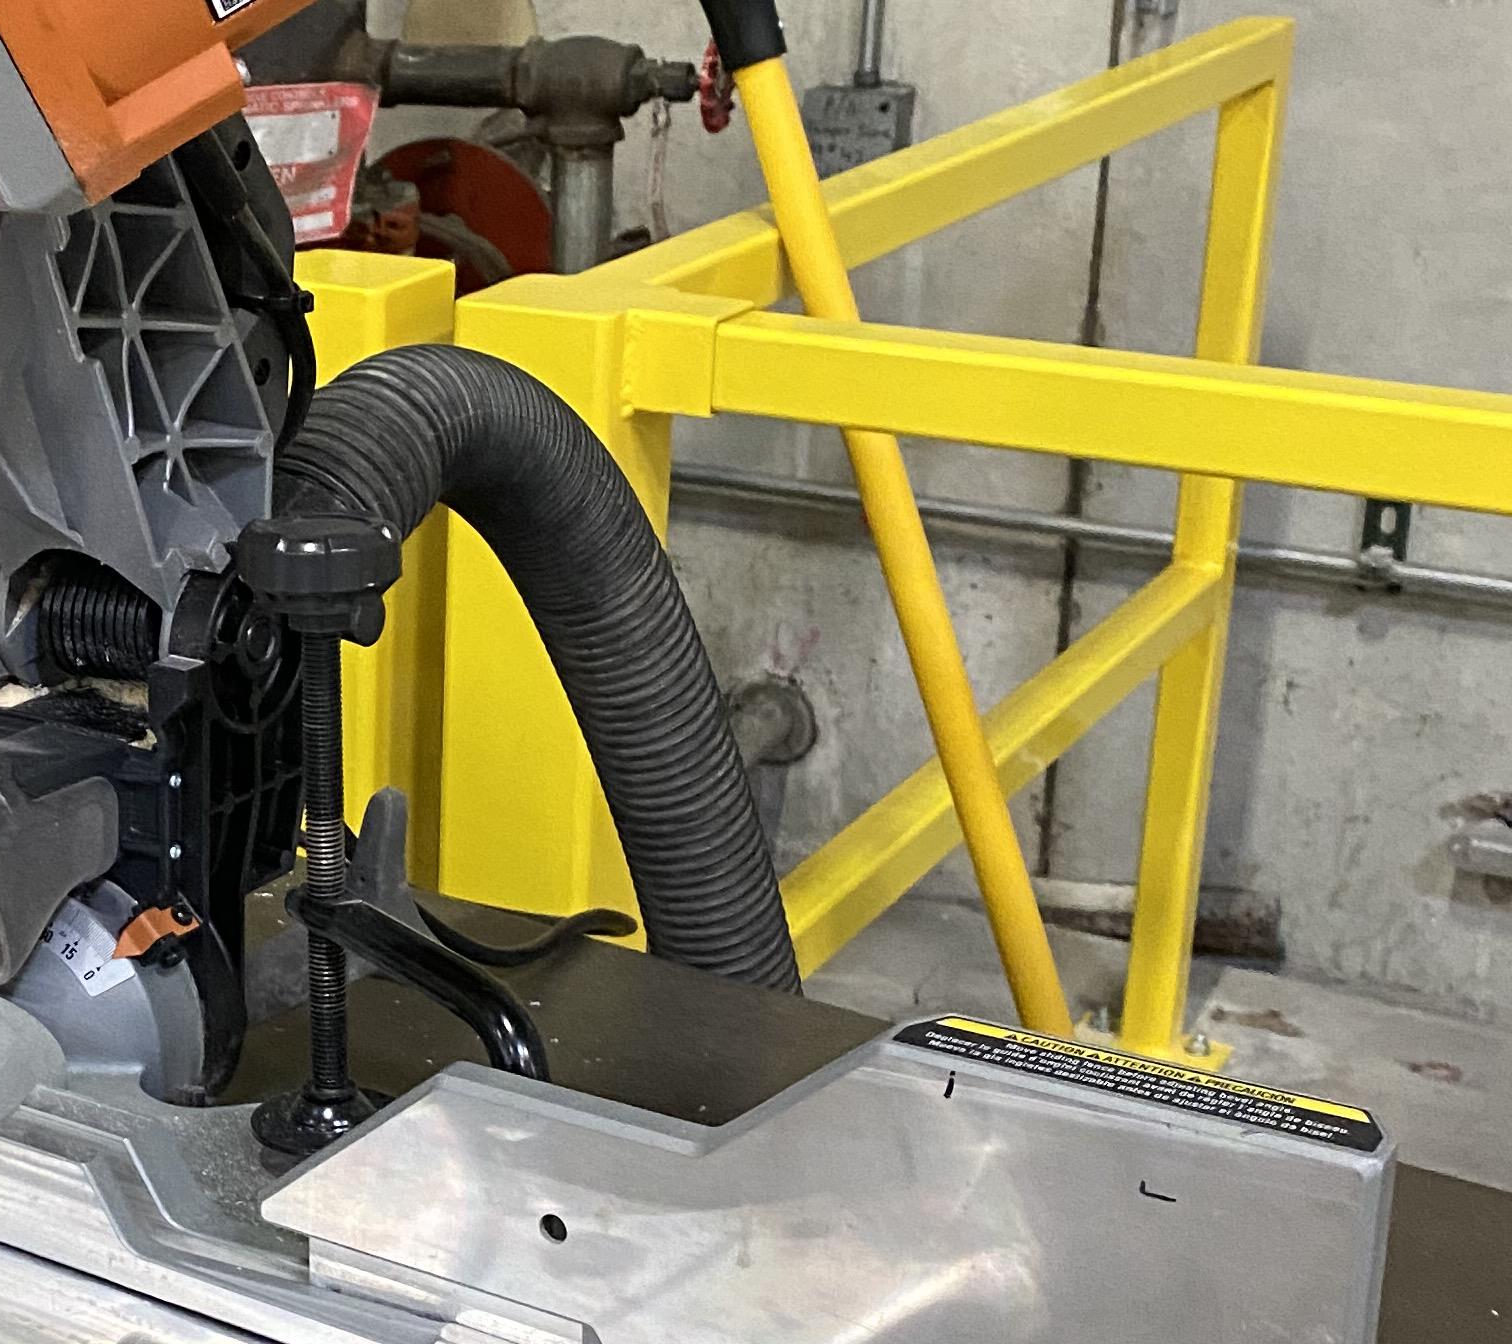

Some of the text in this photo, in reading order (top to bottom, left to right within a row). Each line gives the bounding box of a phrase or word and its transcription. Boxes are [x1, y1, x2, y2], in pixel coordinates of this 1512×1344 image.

[60, 942, 79, 960] 15
[1020, 1035, 1085, 1056] CAUTION
[1102, 1054, 1184, 1080] ATTENTION
[1219, 1091, 1253, 1105] bevel
